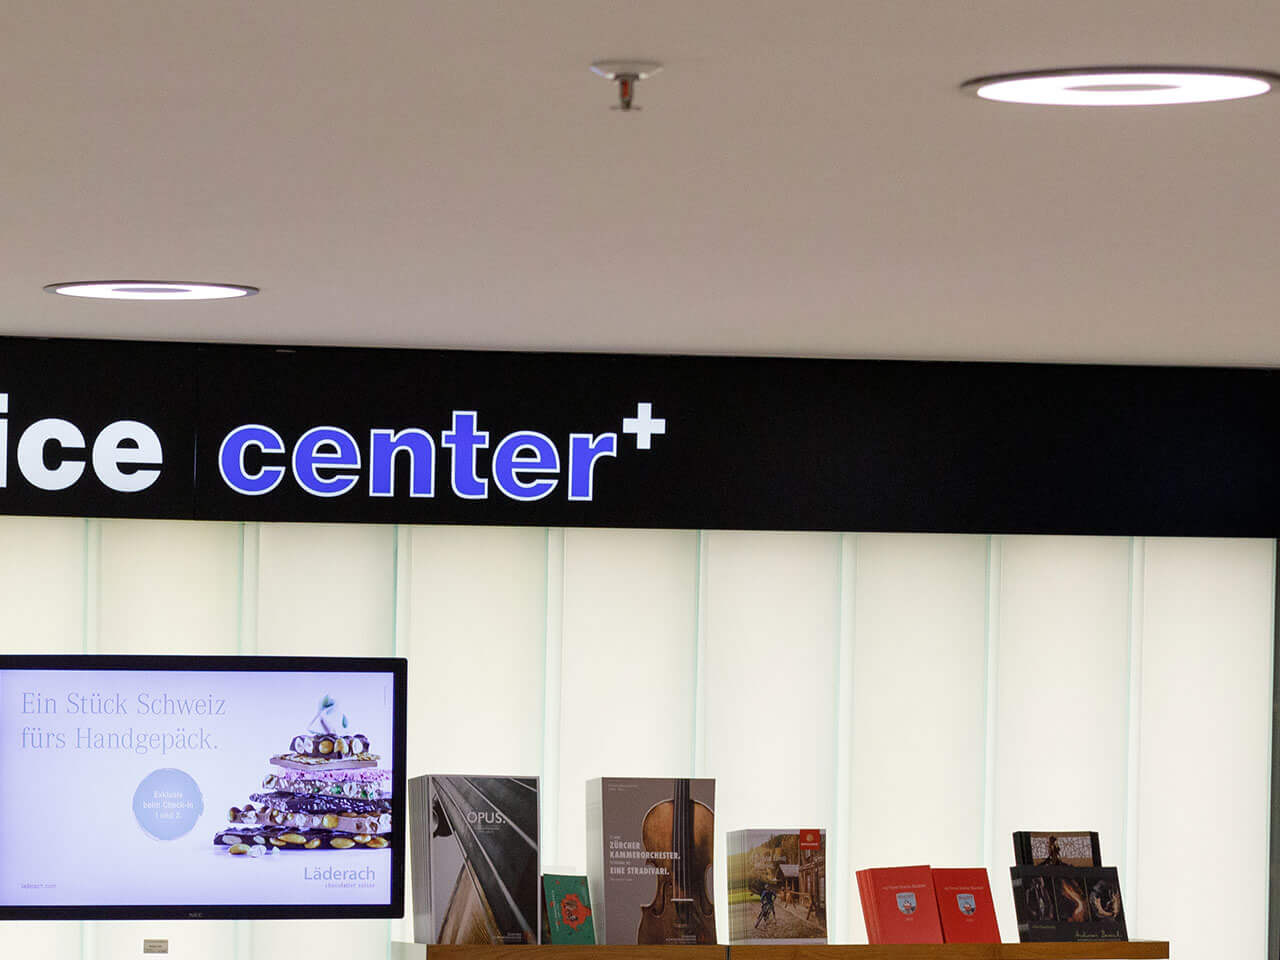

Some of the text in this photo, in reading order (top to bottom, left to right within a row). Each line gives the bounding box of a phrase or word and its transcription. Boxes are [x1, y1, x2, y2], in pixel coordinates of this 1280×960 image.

[20, 691, 226, 716] Ein Stück Schweiz
[19, 726, 219, 755] fürs Handgepäck.
[466, 811, 507, 825] OPUS.
[609, 839, 641, 849] ZÜRCHER
[609, 851, 681, 860] KAMMERORCHESTER.
[303, 865, 376, 881] Läderach
[609, 866, 670, 876] EINE STRADIVARI.
